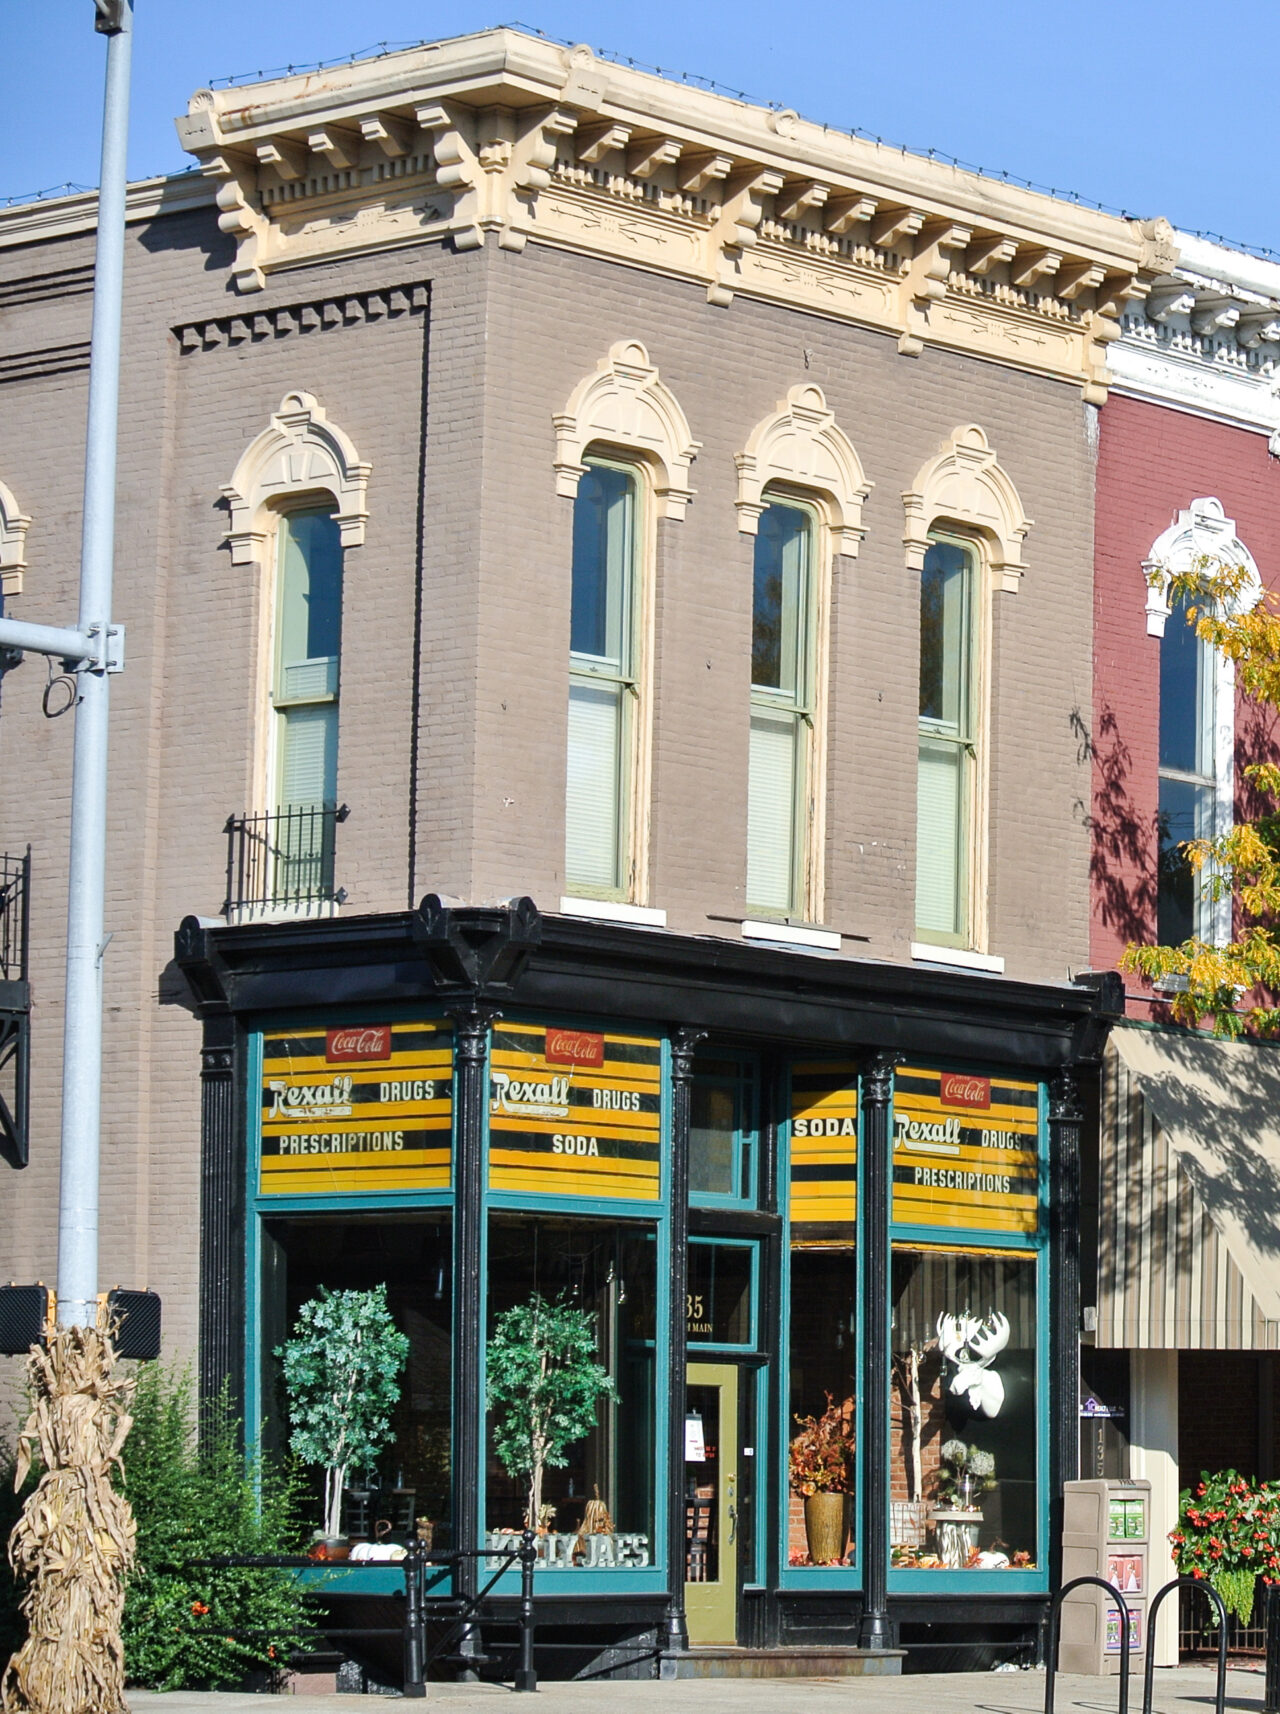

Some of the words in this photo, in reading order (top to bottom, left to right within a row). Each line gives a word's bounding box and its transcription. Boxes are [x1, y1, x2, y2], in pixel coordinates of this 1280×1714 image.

[269, 1075, 353, 1118] Rexall
[380, 1080, 434, 1102] DRUGS
[492, 1072, 569, 1117] Rexall
[593, 1089, 640, 1111] DRUGS
[794, 1118, 856, 1136] SODA
[894, 1113, 961, 1155] Rexall
[981, 1129, 1022, 1150] DRUGS
[279, 1131, 404, 1155] PRESCRIPTIONS
[552, 1134, 599, 1157] SODA
[914, 1167, 1011, 1193] PRESCRIPTIONS
[692, 1323, 713, 1333] MAIN
[581, 1533, 649, 1568] JAES
